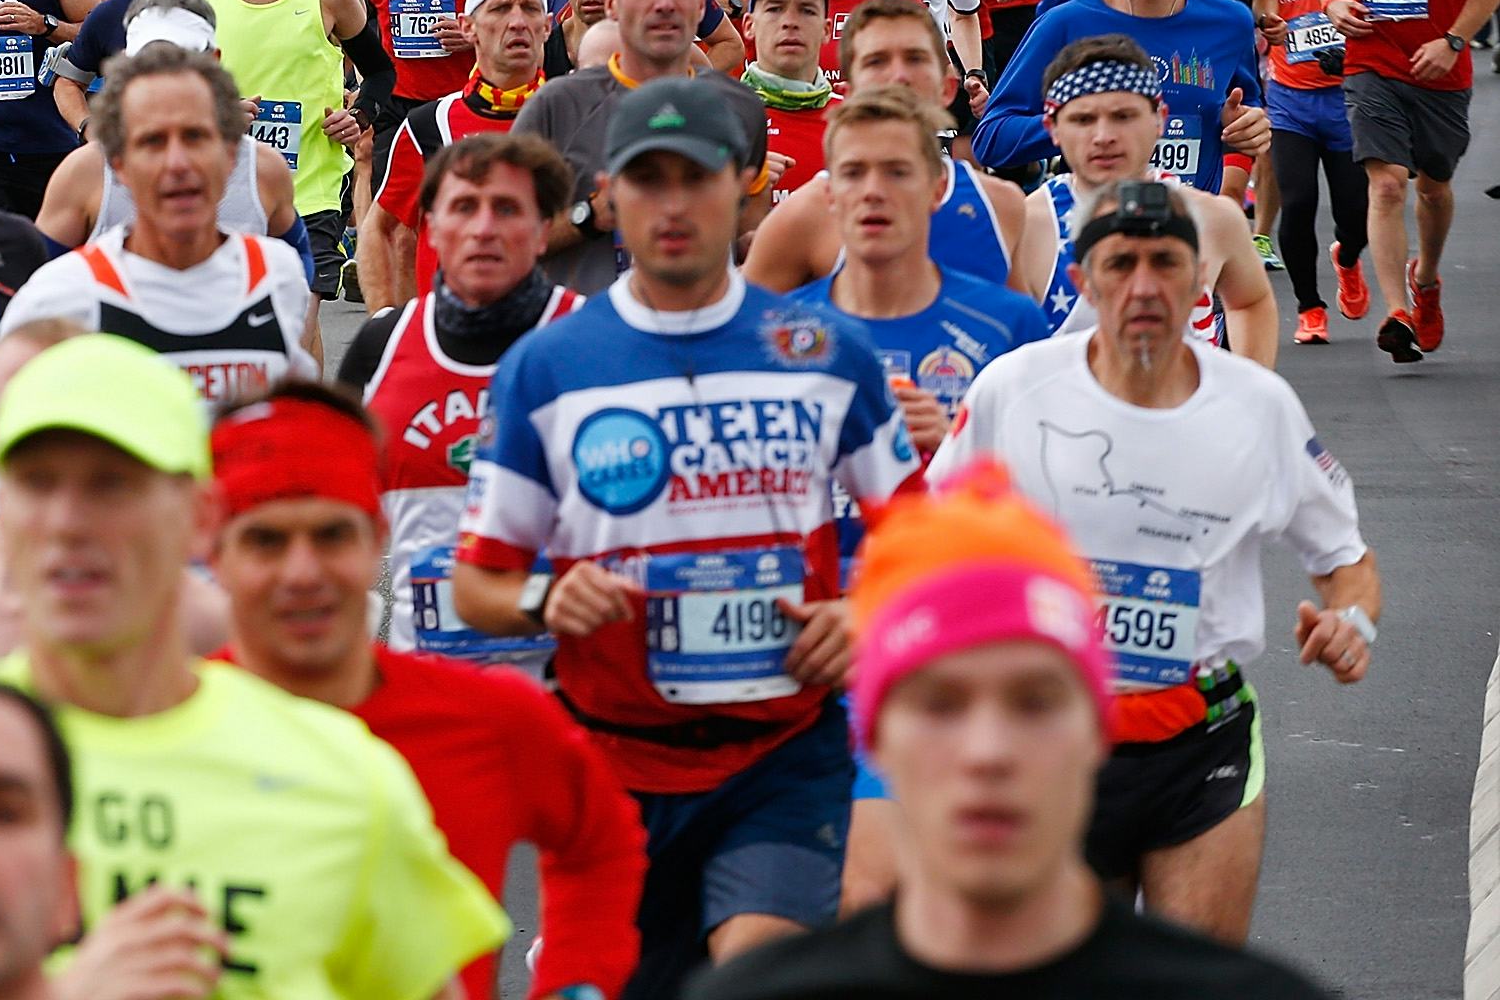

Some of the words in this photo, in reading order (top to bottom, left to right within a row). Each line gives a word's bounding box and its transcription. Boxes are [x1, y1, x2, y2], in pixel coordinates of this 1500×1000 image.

[409, 16, 441, 35] 762
[1148, 143, 1189, 171] 499
[658, 400, 823, 444] TEEN
[669, 438, 816, 477] CANCE
[668, 466, 812, 501] AMERIC
[95, 791, 175, 851] GO
